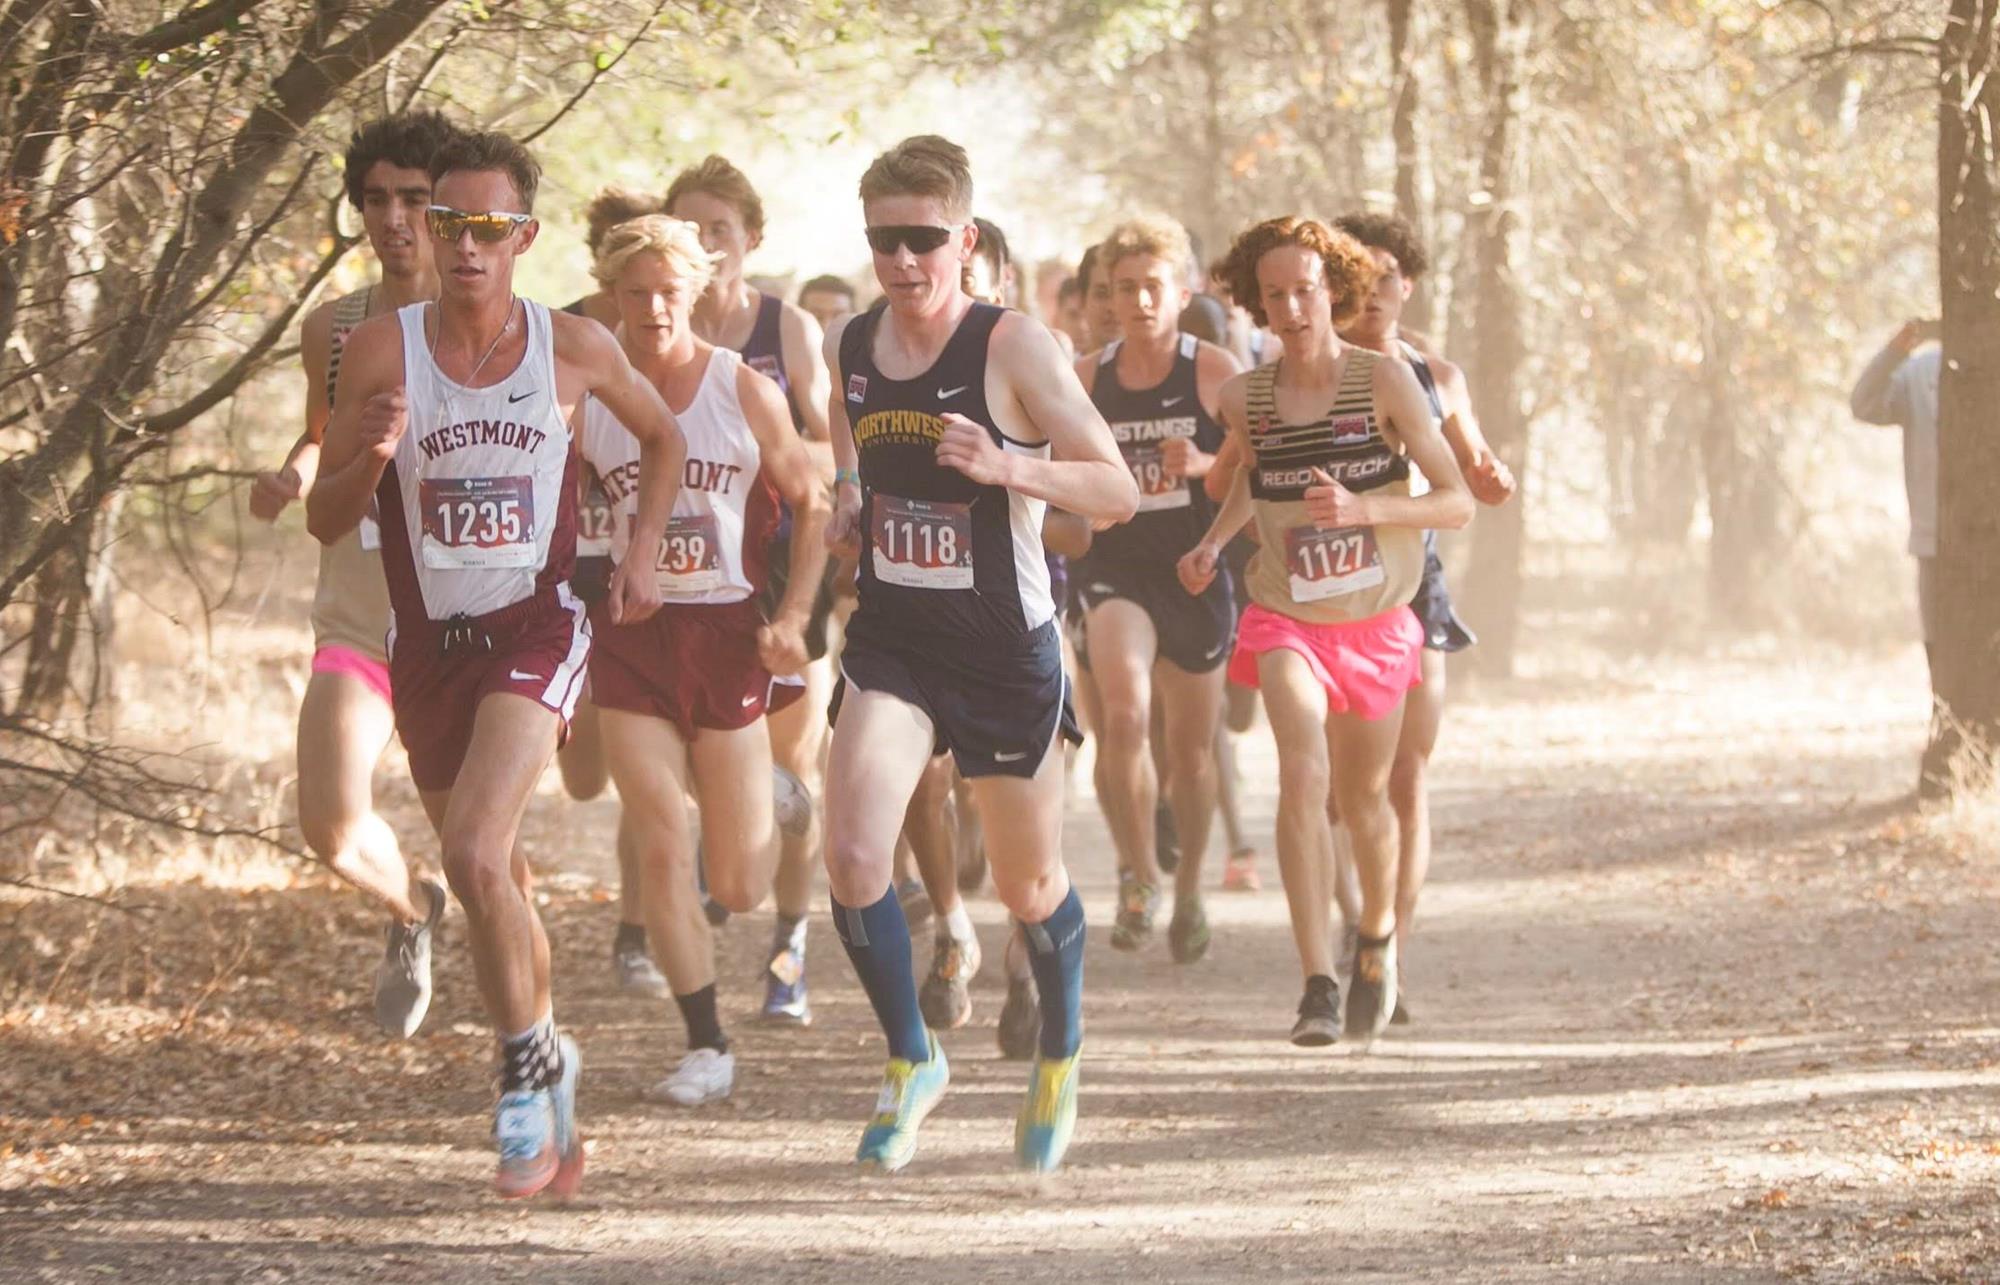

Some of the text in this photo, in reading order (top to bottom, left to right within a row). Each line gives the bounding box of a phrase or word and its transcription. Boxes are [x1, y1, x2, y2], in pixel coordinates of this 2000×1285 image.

[419, 420, 546, 461] WESTMONT
[854, 409, 945, 448] NORTHWES
[865, 434, 934, 449] UNIVERSIT
[1111, 416, 1197, 442] STANGS
[602, 458, 742, 505] WESONT
[1261, 457, 1392, 487] REGO TECH
[437, 500, 521, 543] 1235
[580, 507, 612, 537] 12
[656, 535, 706, 571] 239
[884, 519, 956, 564] 1118
[1298, 534, 1364, 579] 1127
